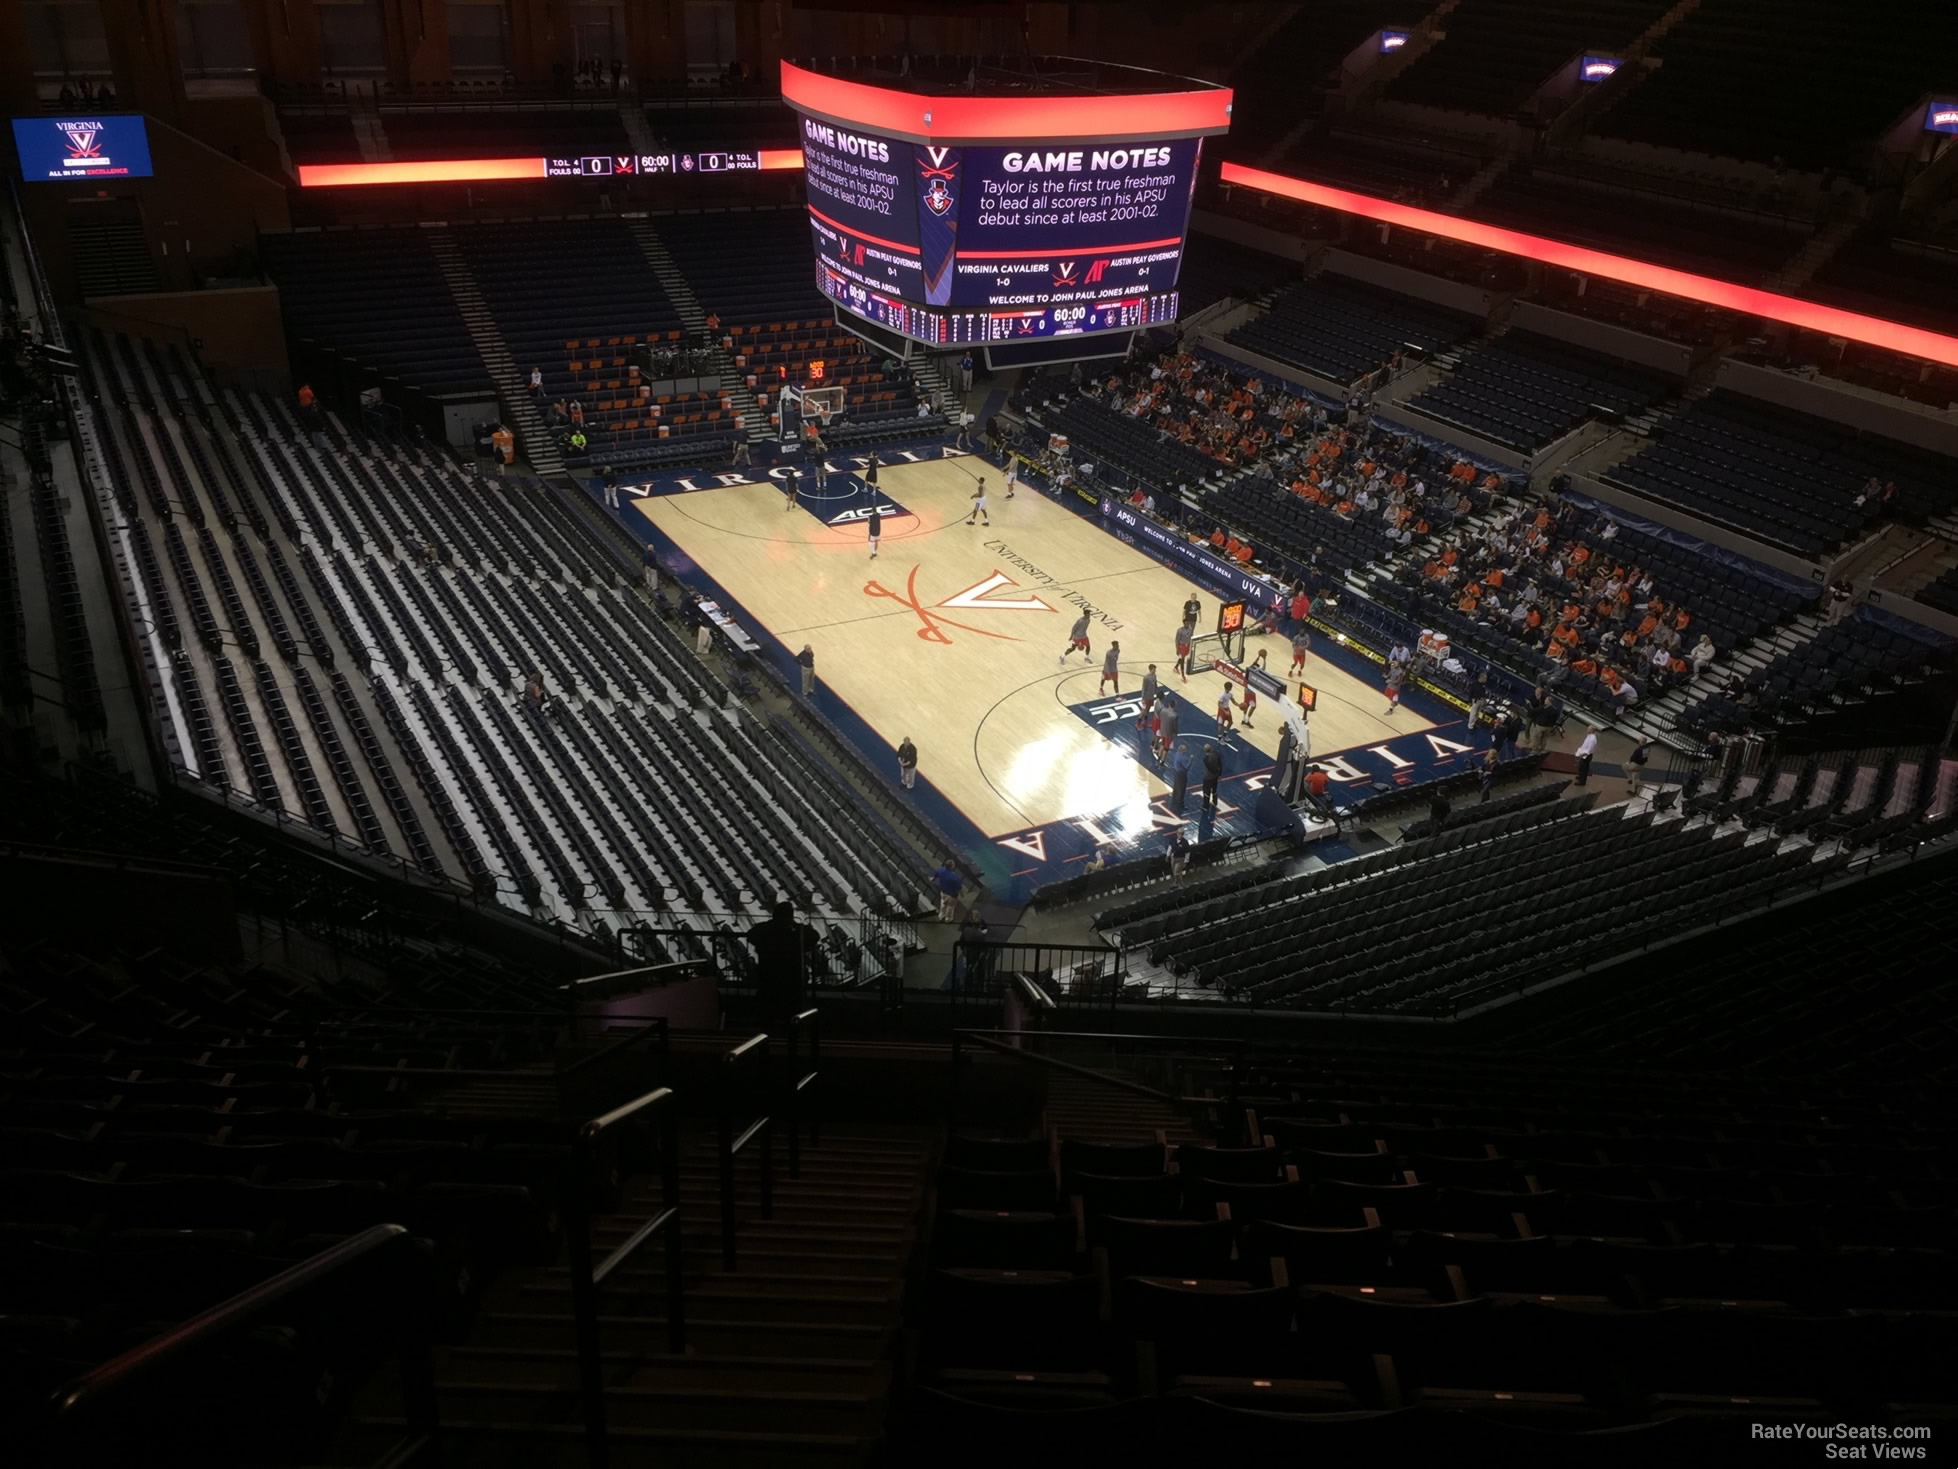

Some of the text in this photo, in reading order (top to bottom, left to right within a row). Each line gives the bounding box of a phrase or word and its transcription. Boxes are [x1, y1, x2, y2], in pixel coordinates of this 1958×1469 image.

[56, 122, 104, 131] VIRGINIA
[805, 119, 890, 163] GAME NOTES
[591, 159, 602, 173] 0
[641, 156, 669, 167] 60:00
[709, 155, 719, 169] 0
[1002, 146, 1171, 173] GAME NOTES
[87, 168, 128, 176] EXCELLENCE
[830, 154, 844, 172] first
[844, 161, 859, 176] true
[859, 164, 899, 186] freshman
[826, 171, 848, 188] scorers
[849, 176, 856, 190] in
[857, 179, 868, 194] his
[869, 184, 894, 201] APSU
[982, 174, 1176, 196] Taylor is the first true freshman
[819, 180, 833, 196] since
[833, 188, 841, 200] at
[840, 189, 857, 206] least
[857, 194, 892, 216] 2001-02.
[980, 188, 1167, 210] to lead all scorers in his APSU
[978, 205, 1159, 226] debut since at least 2001-02.
[866, 248, 923, 271] AUSTIN PEAY GOVERNORS
[1110, 250, 1180, 268] AUSTIN PEAY GOVERNORS
[887, 267, 898, 277] 0-1
[957, 264, 1050, 274] VIRGINIA CAVALIERS
[1138, 267, 1150, 276] 0-1
[853, 271, 865, 283] PAUL
[864, 276, 881, 290] JONES
[881, 283, 902, 296] ARENA
[996, 278, 1011, 287] 1-0
[849, 284, 867, 303] 60:00
[989, 283, 1149, 305] WELCOME TO JOHN PAUL JONES ARENA
[1053, 307, 1086, 322] 60:00
[1089, 314, 1097, 325] 0
[1038, 319, 1046, 330] 0
[810, 367, 824, 379] 30
[828, 504, 896, 524] ACC
[1116, 509, 1136, 526] APSU
[1144, 526, 1165, 543] WELCOME
[1166, 537, 1173, 546] TO
[1215, 566, 1232, 579] ARENA
[983, 539, 1056, 585] UNIVERSITY
[1060, 590, 1124, 632] VIRGINIA
[1241, 579, 1261, 598] UVA
[1223, 612, 1241, 629] 30
